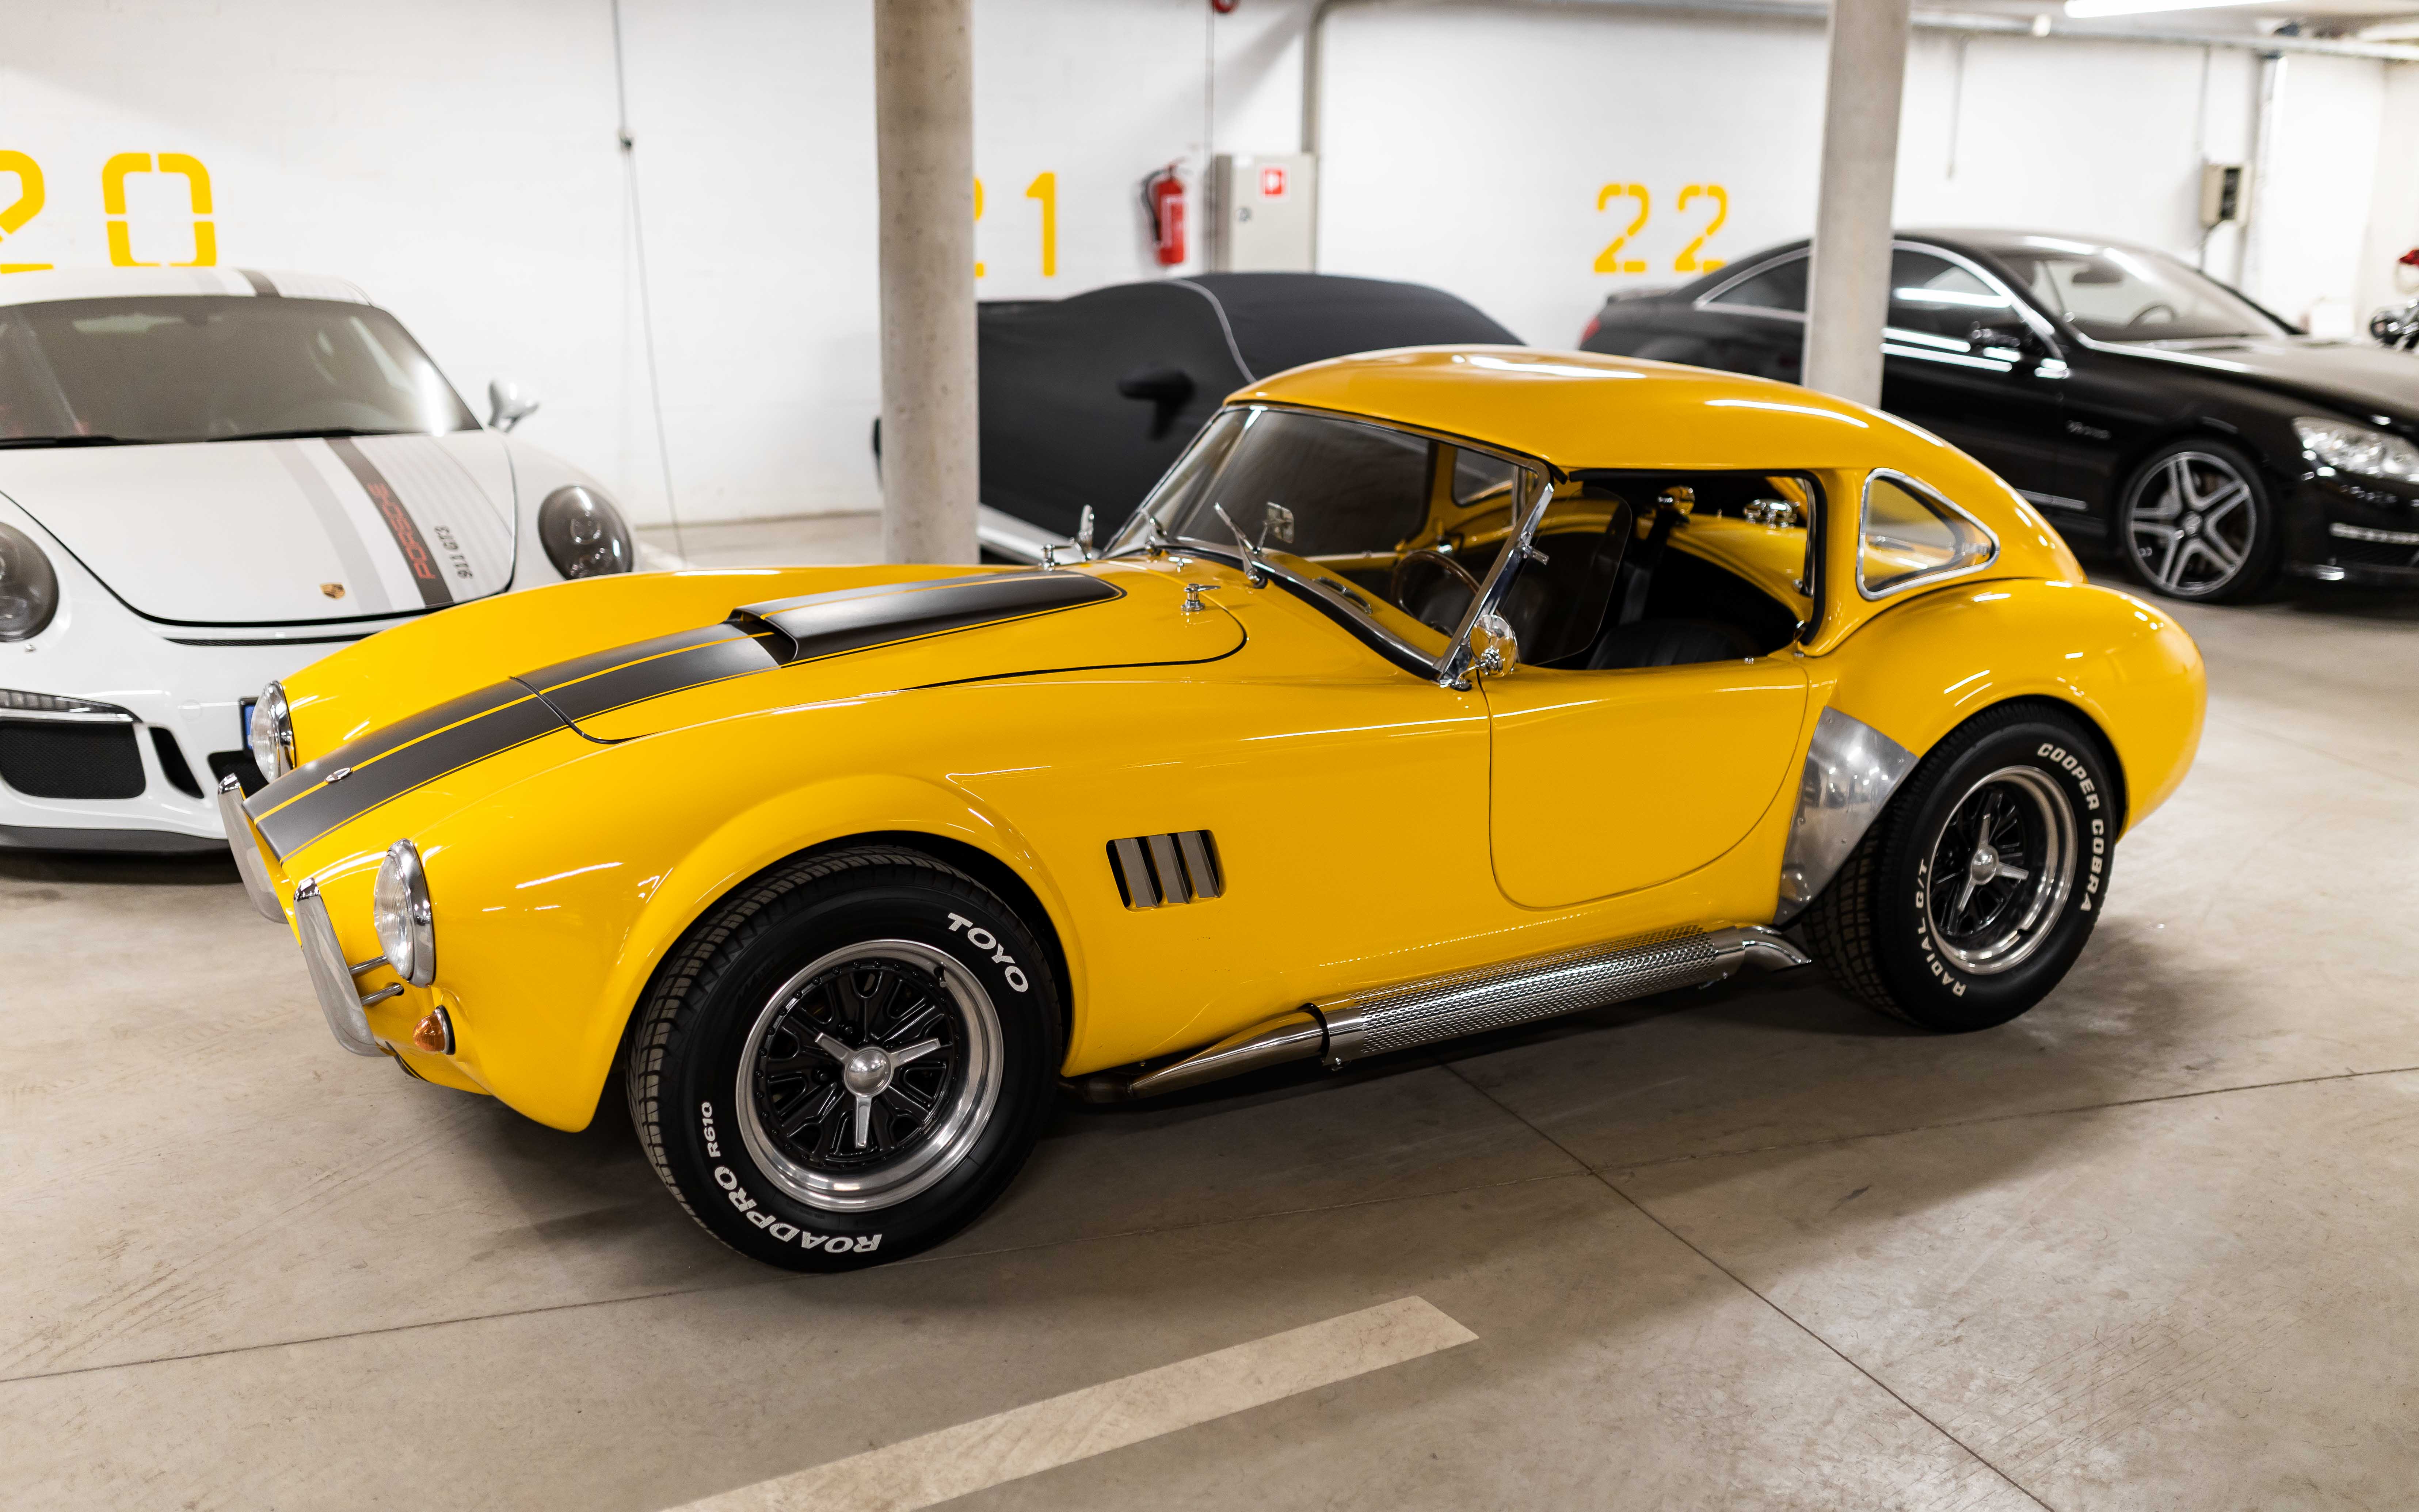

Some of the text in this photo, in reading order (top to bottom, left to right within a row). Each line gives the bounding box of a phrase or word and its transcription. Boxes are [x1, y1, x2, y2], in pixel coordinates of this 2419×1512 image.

[973, 171, 1057, 278] 1
[1594, 183, 1728, 274] 22
[368, 483, 436, 579] PORSCHE
[435, 526, 473, 579] 911 GT3
[2038, 743, 2104, 911] COOPER COBRA
[948, 912, 1028, 992] TOYO
[1916, 858, 1966, 997] RADIAL G/T
[701, 1101, 882, 1253] ROADPRO R610
